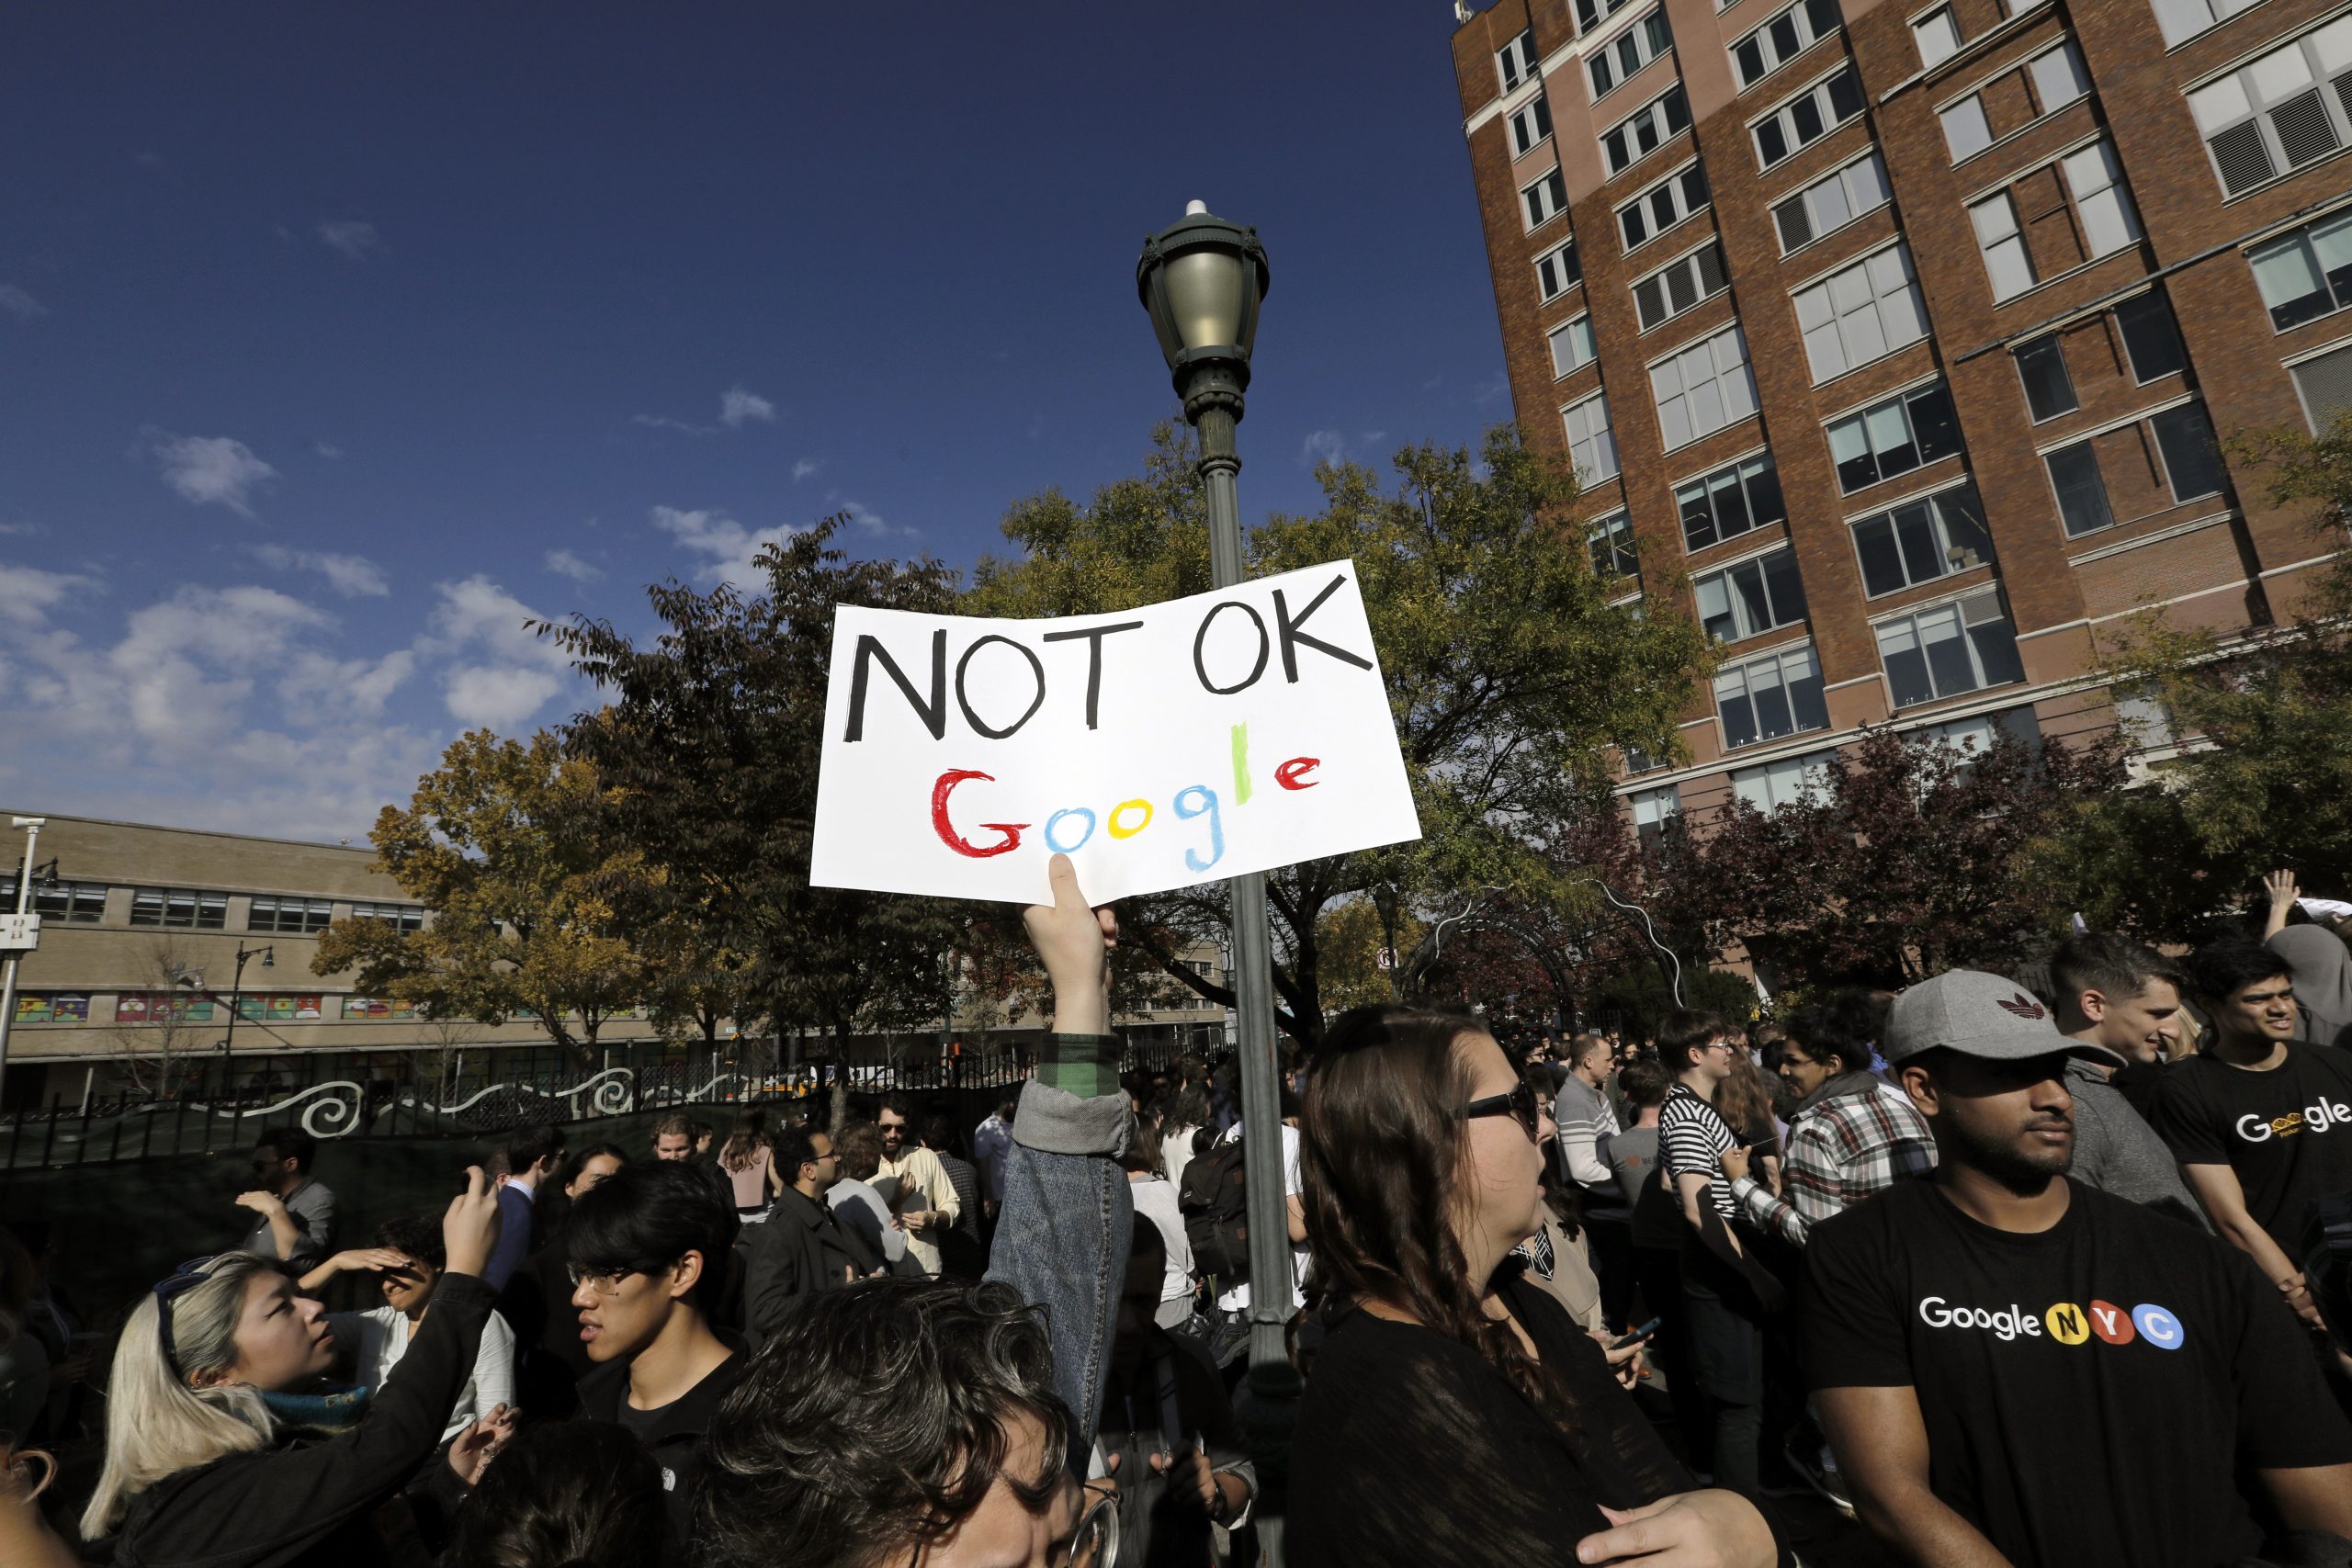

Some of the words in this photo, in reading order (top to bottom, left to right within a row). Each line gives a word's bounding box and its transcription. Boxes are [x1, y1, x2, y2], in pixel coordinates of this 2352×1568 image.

[843, 621, 1144, 742] NOT
[1193, 574, 1374, 695] OK
[931, 721, 1321, 873] Google
[1919, 1296, 2042, 1341] Google
